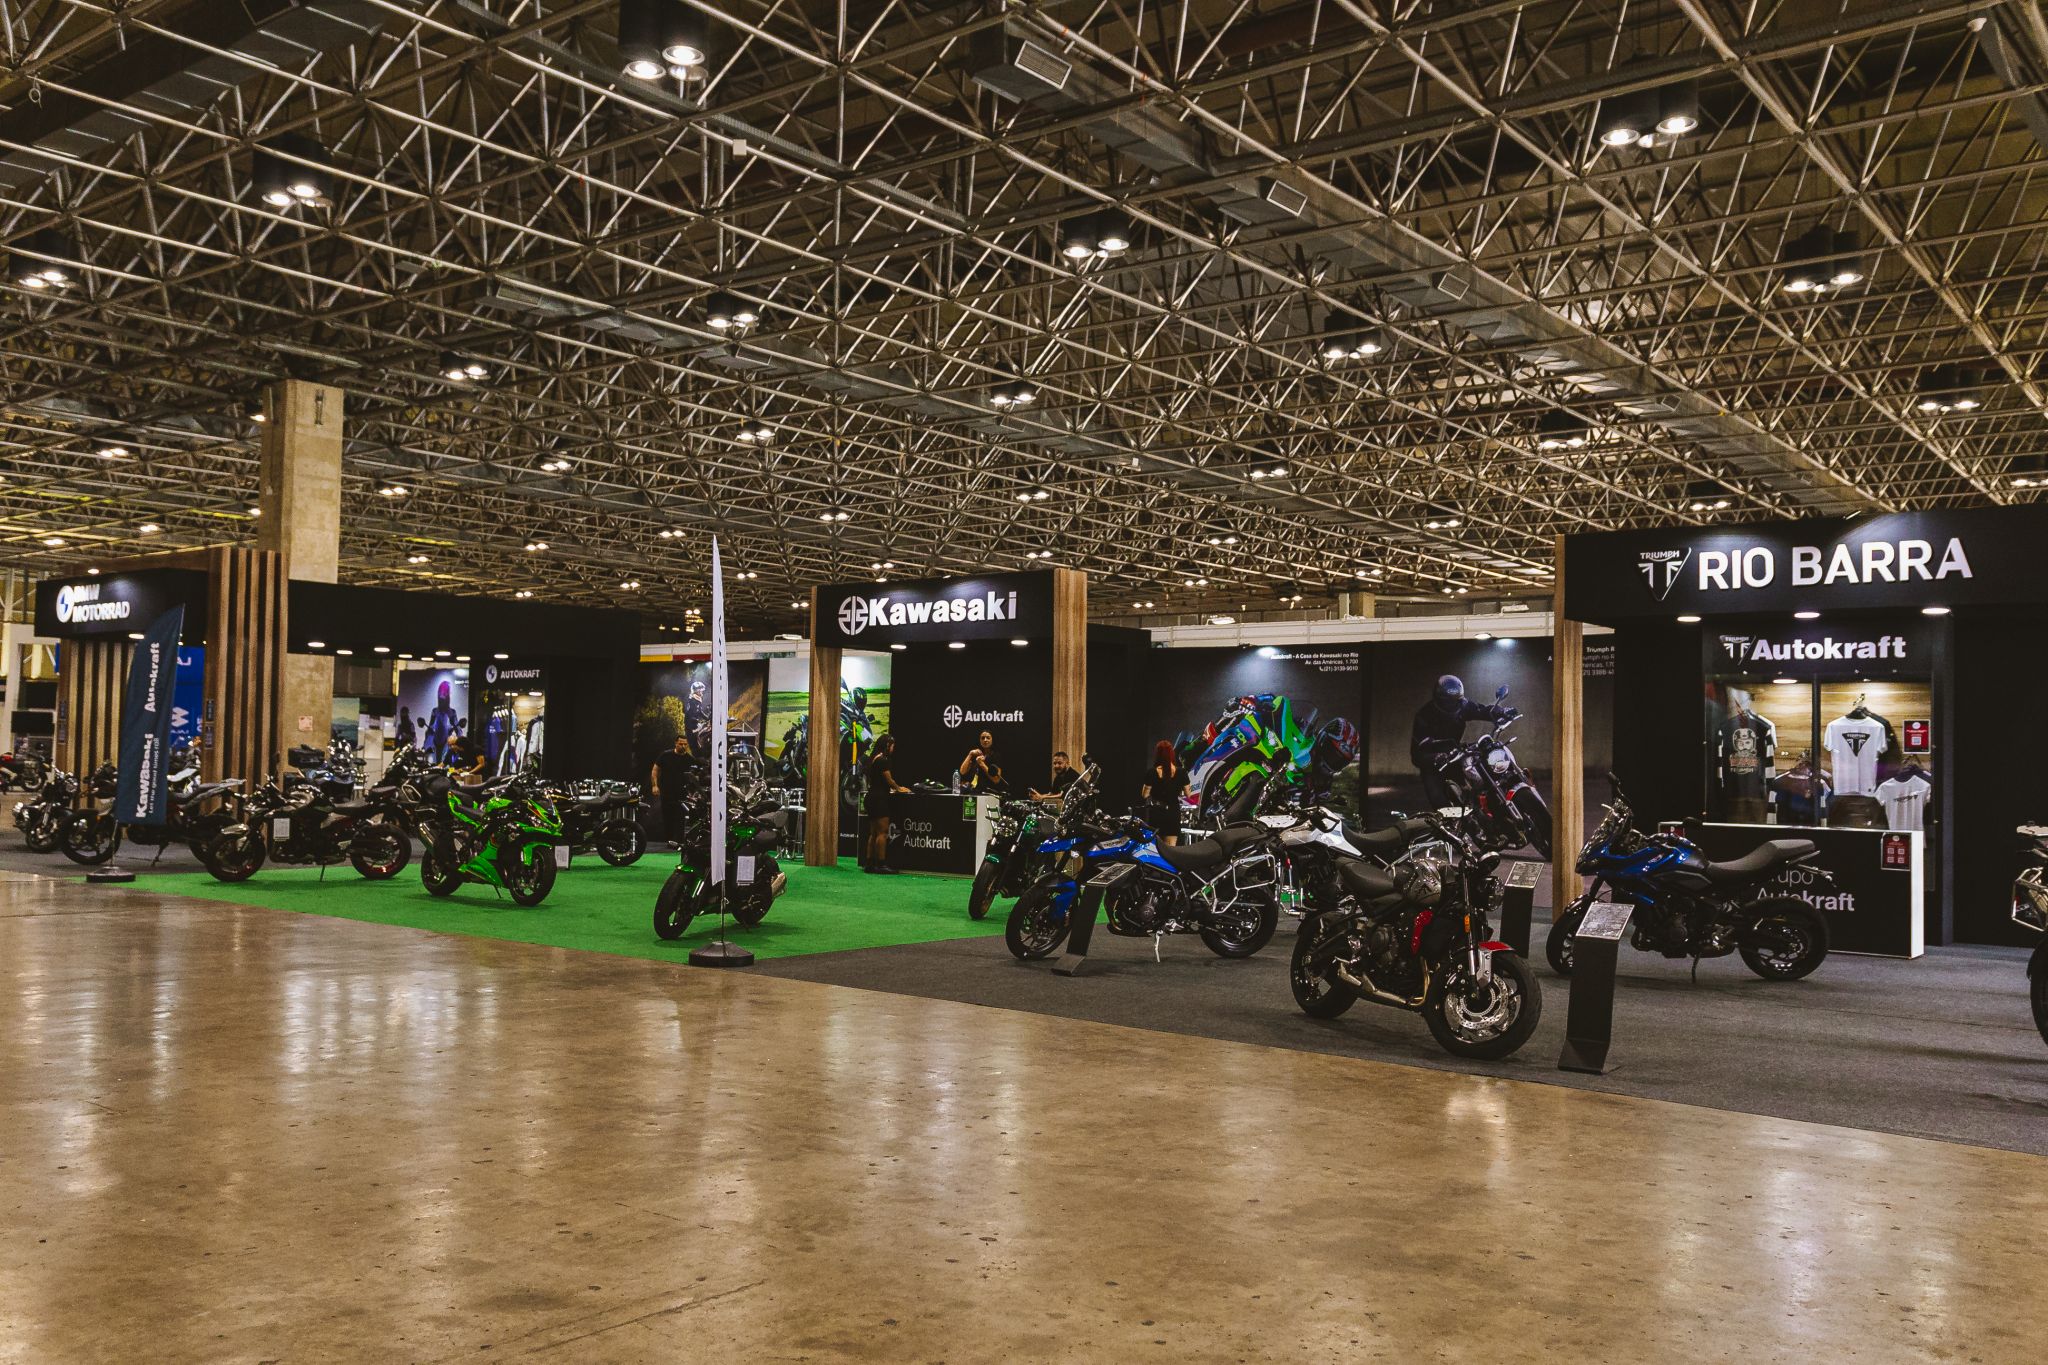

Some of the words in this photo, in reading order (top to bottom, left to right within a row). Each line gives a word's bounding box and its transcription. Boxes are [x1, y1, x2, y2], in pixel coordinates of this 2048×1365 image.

[1640, 550, 1680, 560] TRIUMPH
[1699, 546, 1774, 591] RIO
[1791, 537, 1973, 587] BARRA
[71, 601, 131, 623] MOTORRAD
[868, 591, 1017, 627] Kawasaki
[1751, 636, 1907, 661] Autokraft
[143, 642, 160, 713] Autokraft
[500, 669, 540, 679] AUTOKRAFT
[964, 710, 1024, 722] Autokraft
[135, 733, 154, 819] Kawasaki
[903, 817, 933, 833] Grupo
[903, 834, 951, 850] Autokraft
[1776, 868, 1814, 887] upo
[1757, 887, 1855, 911] Akraft
